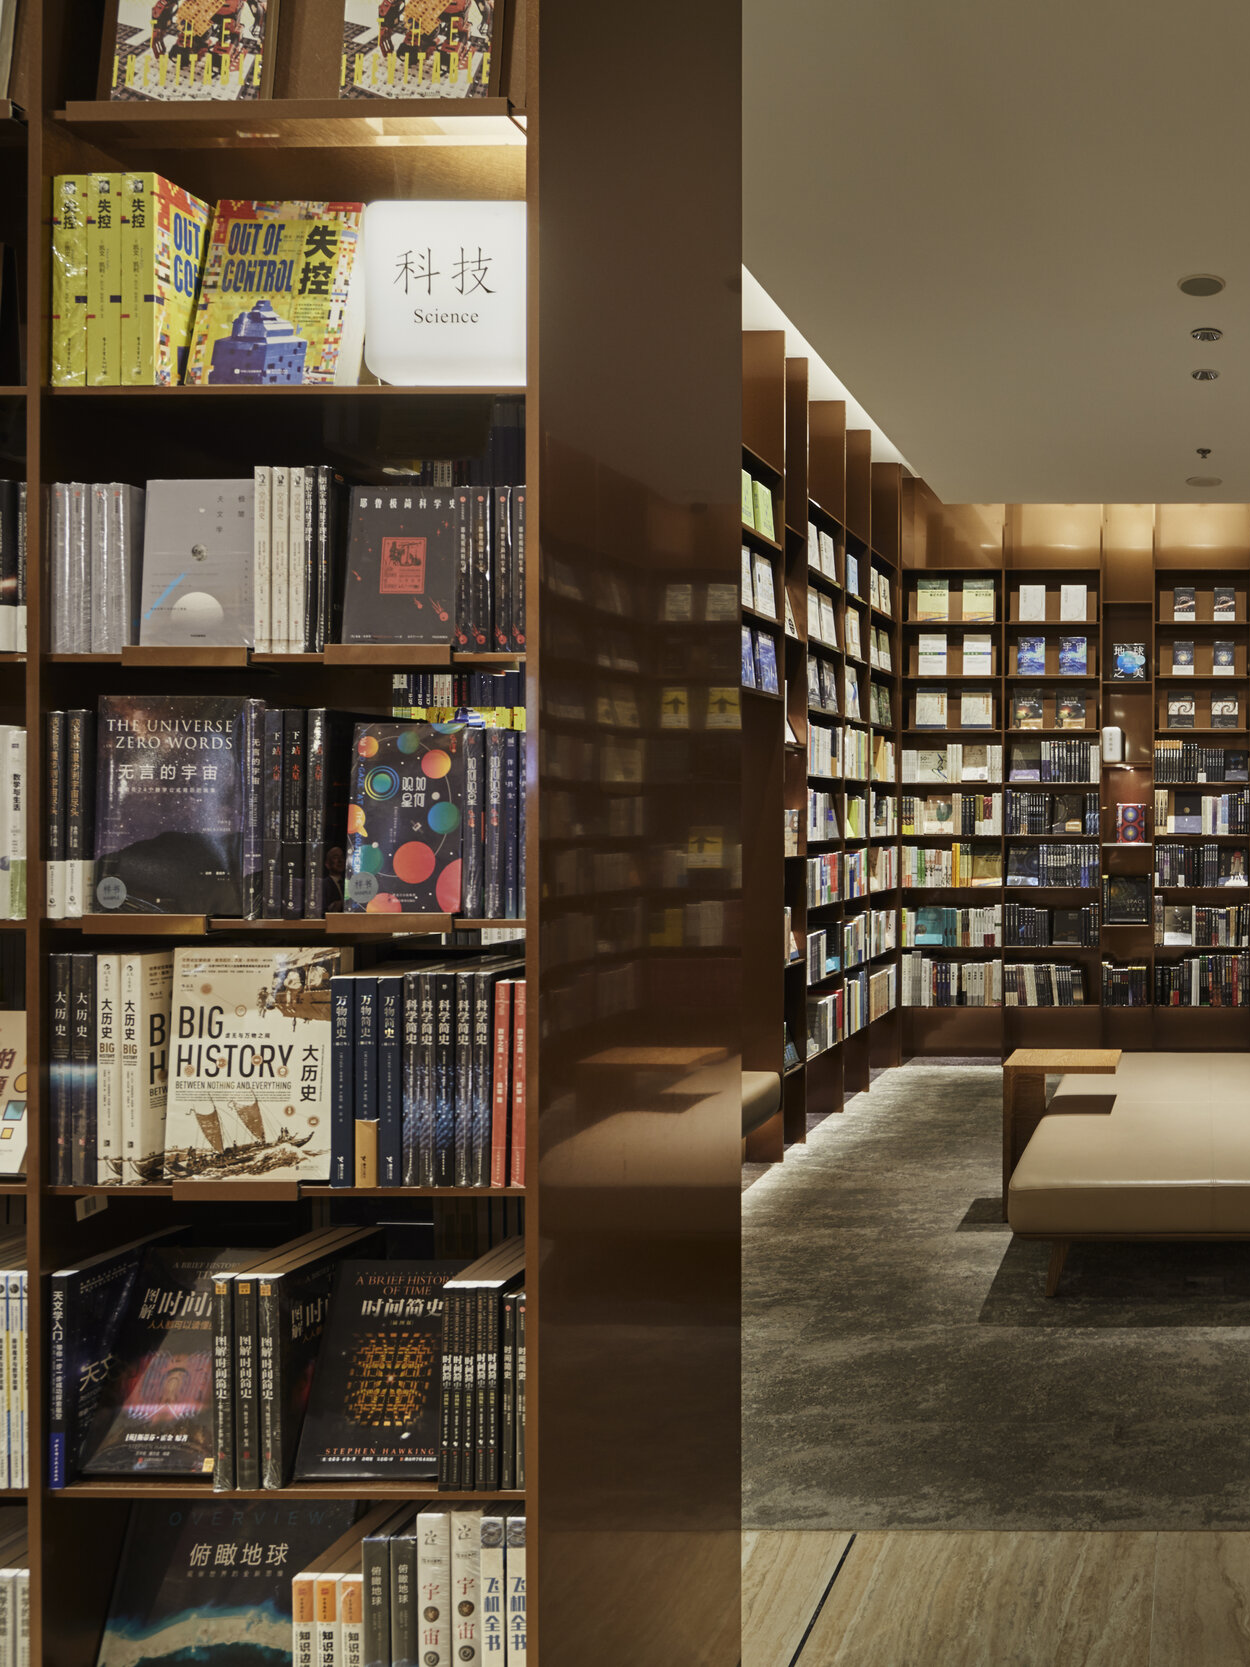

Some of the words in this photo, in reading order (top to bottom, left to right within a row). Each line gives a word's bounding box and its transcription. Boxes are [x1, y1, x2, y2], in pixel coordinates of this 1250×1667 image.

[111, 53, 263, 88] INEVITABLE
[340, 52, 491, 87] INEVITABLE
[97, 198, 112, 229] 失控
[131, 198, 145, 229] 失控
[173, 212, 201, 260] OUT
[228, 222, 263, 256] OUT
[263, 223, 286, 256] OF
[221, 259, 295, 293] CONTROL
[298, 225, 338, 296] 失控
[393, 245, 498, 297] 科技
[413, 307, 480, 325] Science
[359, 497, 456, 509] 耶鲁极简科学史
[1113, 646, 1145, 656] 地球
[107, 719, 139, 732] THE
[147, 719, 234, 732] UNIVERSE
[115, 736, 163, 750] ZERO
[167, 736, 234, 750] WORDS
[118, 764, 219, 781] 无言的宇宙
[251, 738, 261, 785] 无言的宇宙
[352, 832, 363, 874] SOUTHER
[54, 991, 66, 1037] 大历史
[76, 992, 88, 1038] 大历史
[100, 998, 113, 1039] 大历史
[123, 999, 136, 1041] 大历史
[178, 1005, 224, 1039] BIG
[335, 995, 348, 1039] 万物简史
[360, 994, 372, 1038] 万物简史
[384, 996, 395, 1039] 万物简史
[405, 999, 418, 1046] 科学简史
[421, 999, 433, 1046] 科学简史
[438, 999, 451, 1046] 科学简史
[457, 999, 470, 1046] 科学简史
[475, 999, 488, 1046] 科学简史
[99, 1042, 115, 1053] BIG
[123, 1044, 138, 1055] BIG
[176, 1044, 294, 1078] HISTORY
[175, 1081, 205, 1090] BETWEEN
[207, 1081, 235, 1090] NOTHING
[236, 1081, 250, 1090] AND
[251, 1081, 292, 1090] EVERYTHING
[299, 1045, 319, 1103] 大历史
[355, 1276, 364, 1286] A
[368, 1275, 405, 1286] BRIEF
[383, 1286, 400, 1296] OF
[403, 1286, 432, 1296] TIME
[52, 1291, 64, 1341] 天文学入门
[139, 1288, 160, 1320] 图解
[158, 1291, 213, 1318] 时间
[361, 1298, 444, 1318] 时间简史
[215, 1336, 227, 1399] 图解时间简史
[239, 1335, 252, 1399] 图解时间简史
[261, 1337, 274, 1400] 图解时间简史
[169, 1511, 329, 1526] OVERVIEW
[188, 1543, 289, 1567] 俯瞰地球
[370, 1565, 382, 1606] 俯瞰地球
[484, 1577, 501, 1651] 飞机全书
[509, 1577, 527, 1651] 飞机全书
